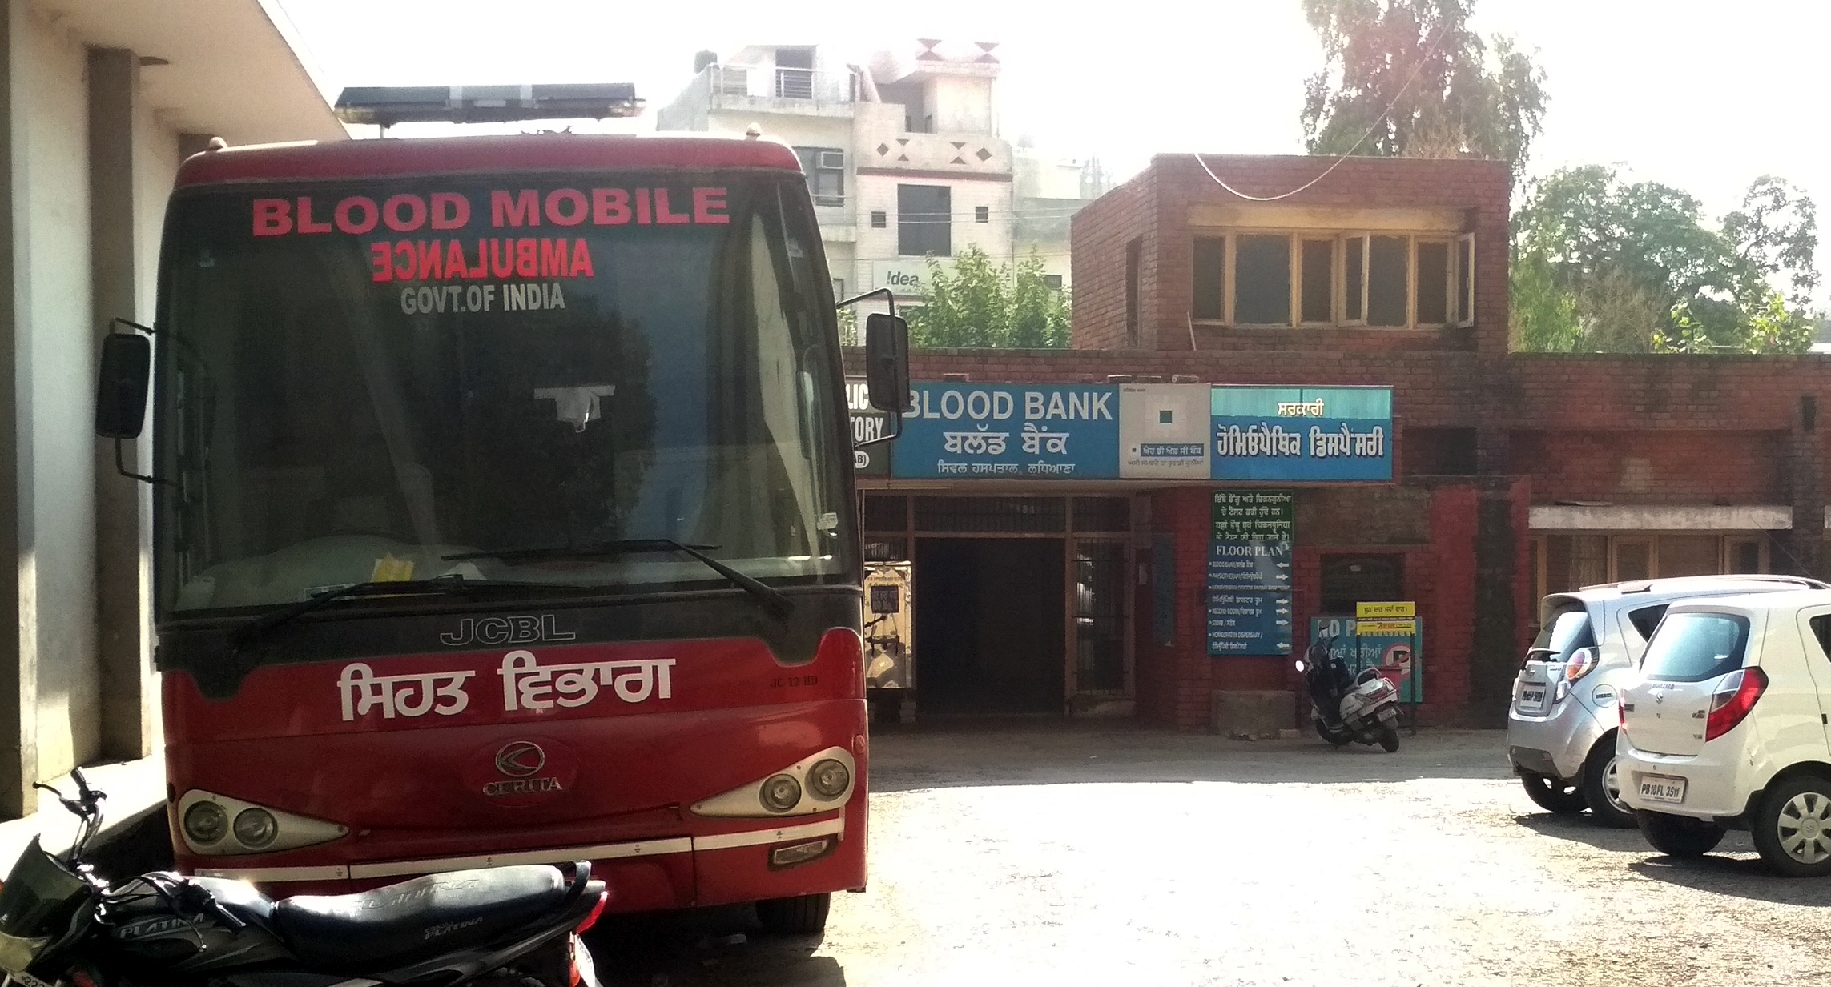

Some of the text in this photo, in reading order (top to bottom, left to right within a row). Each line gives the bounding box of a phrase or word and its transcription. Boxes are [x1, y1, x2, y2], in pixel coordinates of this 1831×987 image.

[252, 186, 730, 236] BLOOD MOBILE
[502, 282, 567, 313] INDIA
[846, 383, 869, 410] LIC
[1024, 391, 1113, 420] BANK
[1277, 398, 1324, 416] ਸਰਕਾਰੀ
[943, 422, 1070, 455] ਬਲੱਡ ਬੈਂਕ
[937, 459, 968, 474] ਸਿਵਲ
[1216, 545, 1283, 557] FLOOR PLAN
[441, 614, 576, 646] JCBL
[337, 650, 676, 721] ਸਿਹਤ ਵਿਭਾਗ
[482, 776, 563, 798] CERITA
